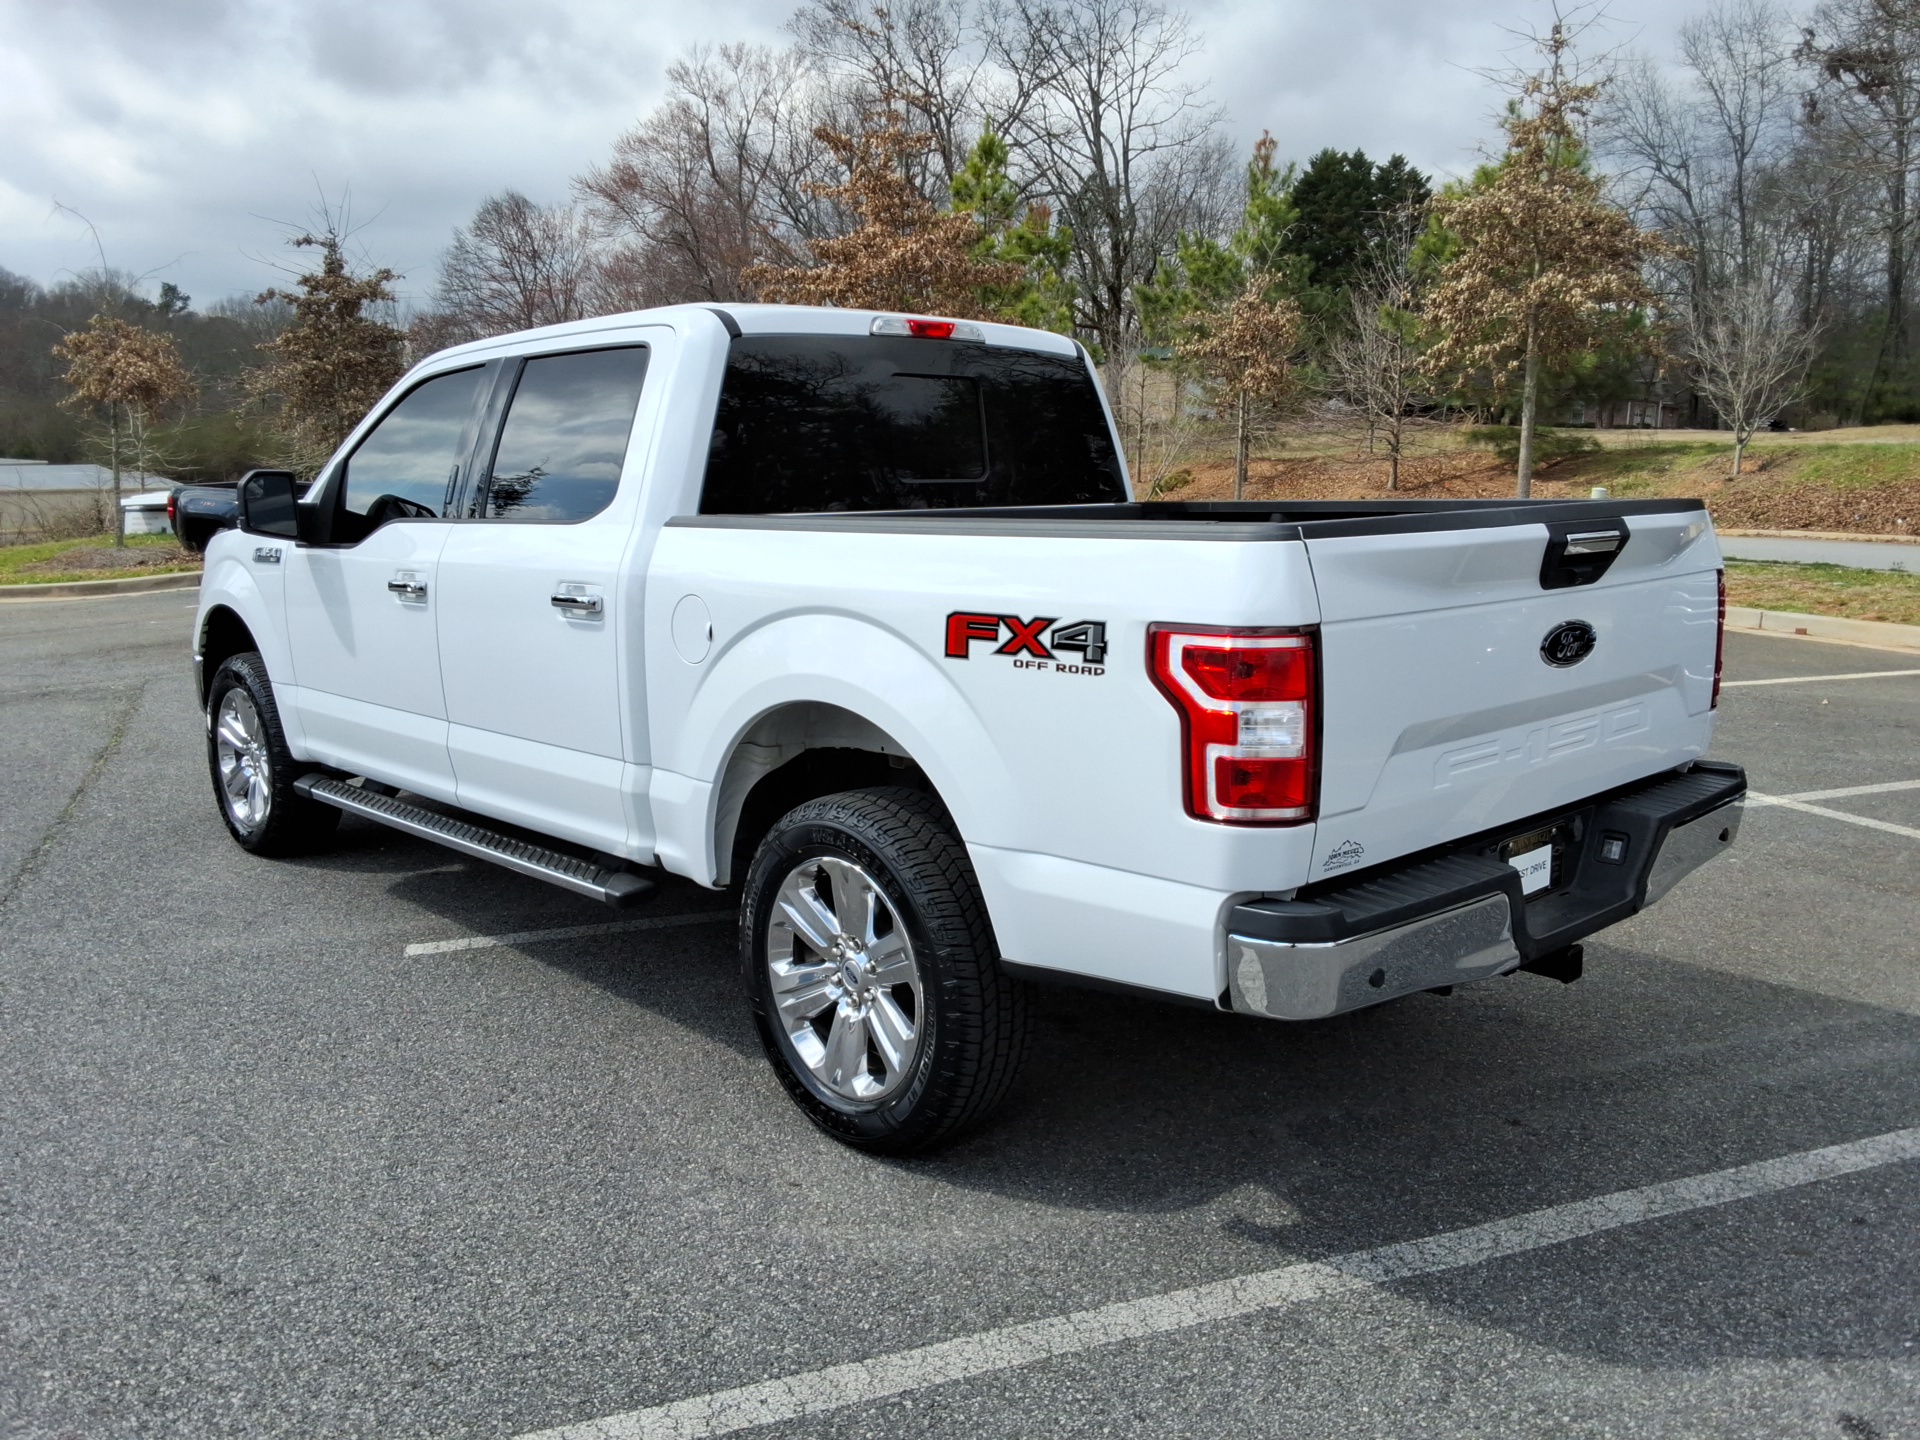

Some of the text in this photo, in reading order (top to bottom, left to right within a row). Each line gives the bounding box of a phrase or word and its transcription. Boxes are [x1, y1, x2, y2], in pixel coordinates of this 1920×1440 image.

[944, 611, 1108, 666] FX4
[1013, 659, 1106, 677] OFF ROAD
[1530, 860, 1546, 875] DRIVE
